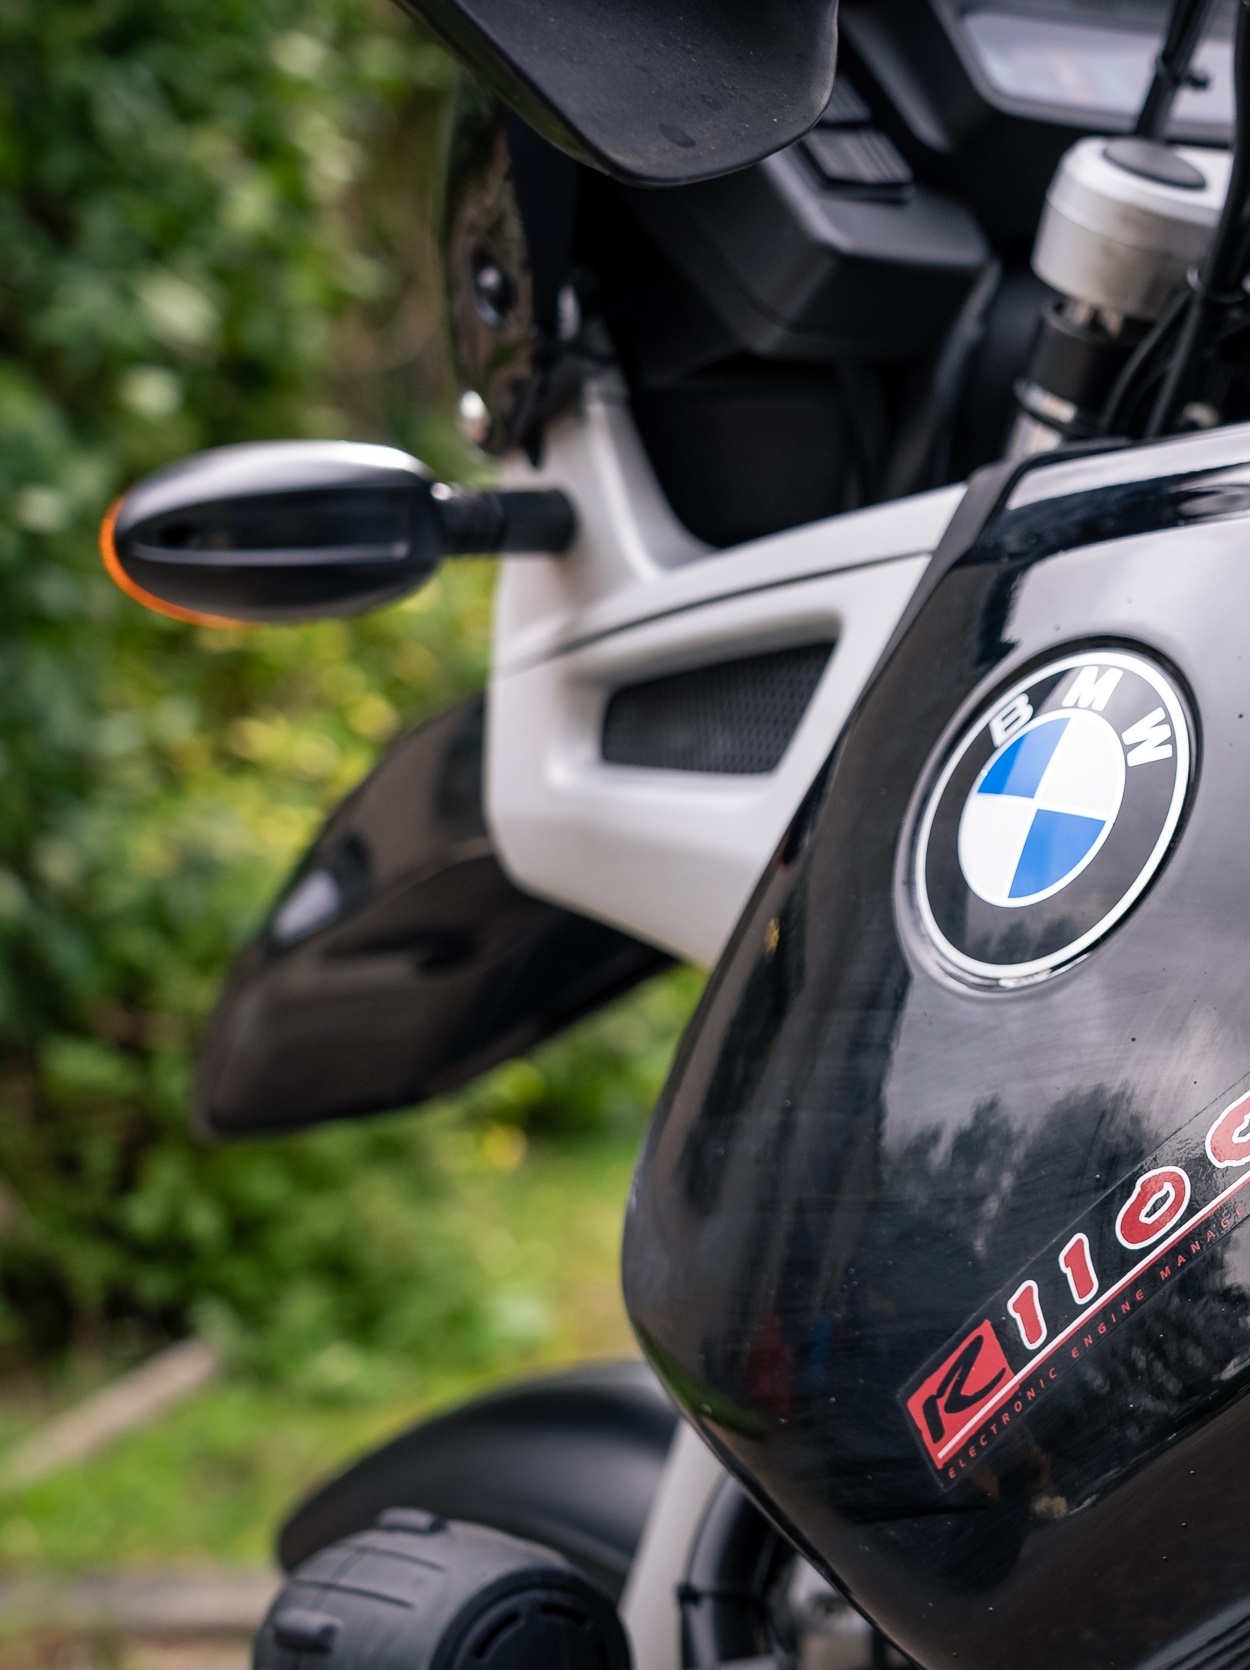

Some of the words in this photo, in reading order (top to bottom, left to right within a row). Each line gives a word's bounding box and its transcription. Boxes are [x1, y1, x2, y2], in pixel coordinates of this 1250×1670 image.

[988, 665, 1173, 768] BMW
[947, 1367, 1058, 1479] ELECTRONIC
[1070, 1288, 1145, 1359] ENGINE
